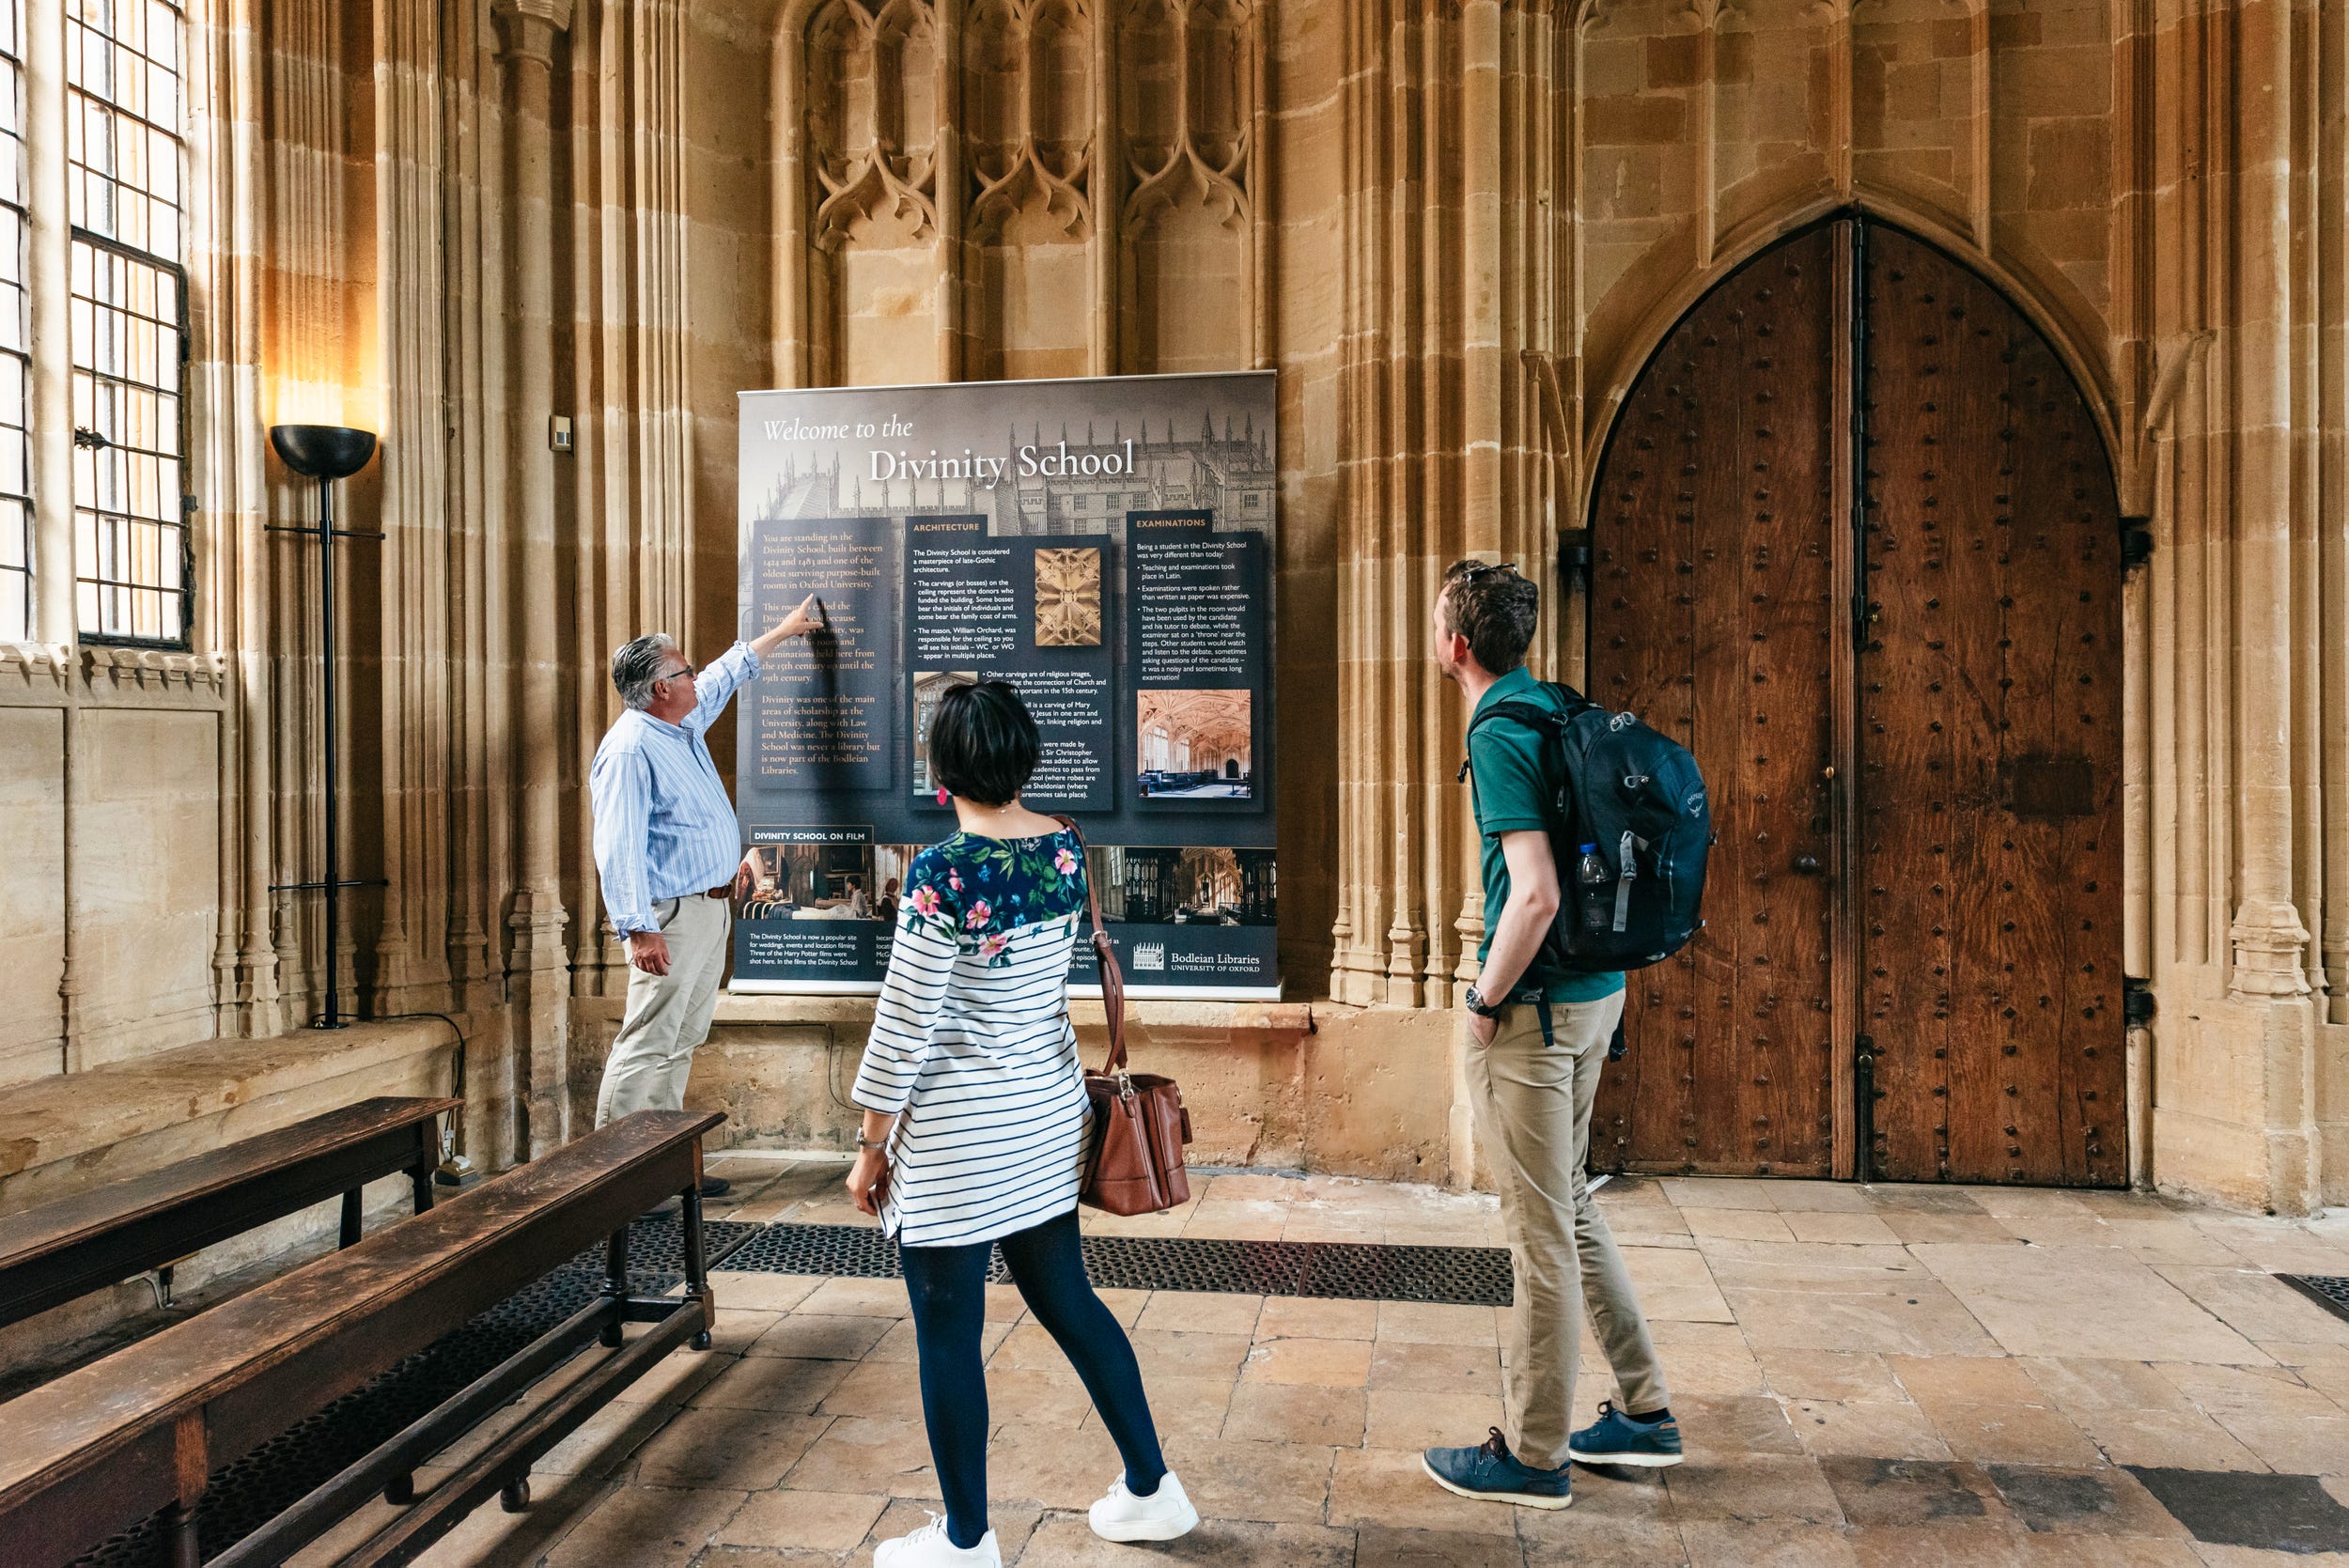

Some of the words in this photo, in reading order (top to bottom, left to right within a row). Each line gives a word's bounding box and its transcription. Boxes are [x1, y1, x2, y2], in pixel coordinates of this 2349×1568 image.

[764, 418, 849, 440] Welcome
[856, 420, 875, 438] to
[883, 414, 913, 437] the
[869, 449, 1006, 490] Divinity
[1018, 438, 1134, 478] School
[763, 533, 778, 542] You
[794, 532, 828, 544] standing
[831, 532, 837, 540] in
[841, 532, 853, 540] the
[763, 545, 794, 556] Divinity
[828, 544, 846, 553] built
[849, 544, 882, 552] between
[1137, 543, 1153, 552] Being
[1203, 542, 1225, 551] Divinity
[927, 549, 949, 558] Divinity
[781, 557, 795, 565] and
[817, 556, 831, 565] and
[850, 556, 859, 564] of
[861, 556, 873, 564] the
[919, 557, 953, 566] masterpiece
[1142, 564, 1167, 573] Teaching
[763, 569, 785, 577] oldest
[788, 568, 824, 579] surviving
[827, 568, 880, 579] purpose-built
[1142, 573, 1156, 581] place
[790, 580, 797, 589] in
[800, 580, 827, 588] Oxford
[831, 580, 873, 591] University.
[931, 580, 954, 588] carvings
[966, 579, 987, 588] bosses)
[918, 588, 936, 597] ceiling
[938, 588, 965, 597] represent
[1199, 584, 1220, 593] spoken
[951, 596, 974, 605] building.
[1221, 593, 1250, 601] expensive.
[961, 613, 978, 621] family
[1005, 671, 1027, 679] carvings
[1047, 671, 1069, 679] religious
[1071, 671, 1091, 679] images,
[762, 695, 794, 706] Divinity
[1171, 953, 1214, 963] Bodleian
[1217, 954, 1259, 964] Libraries
